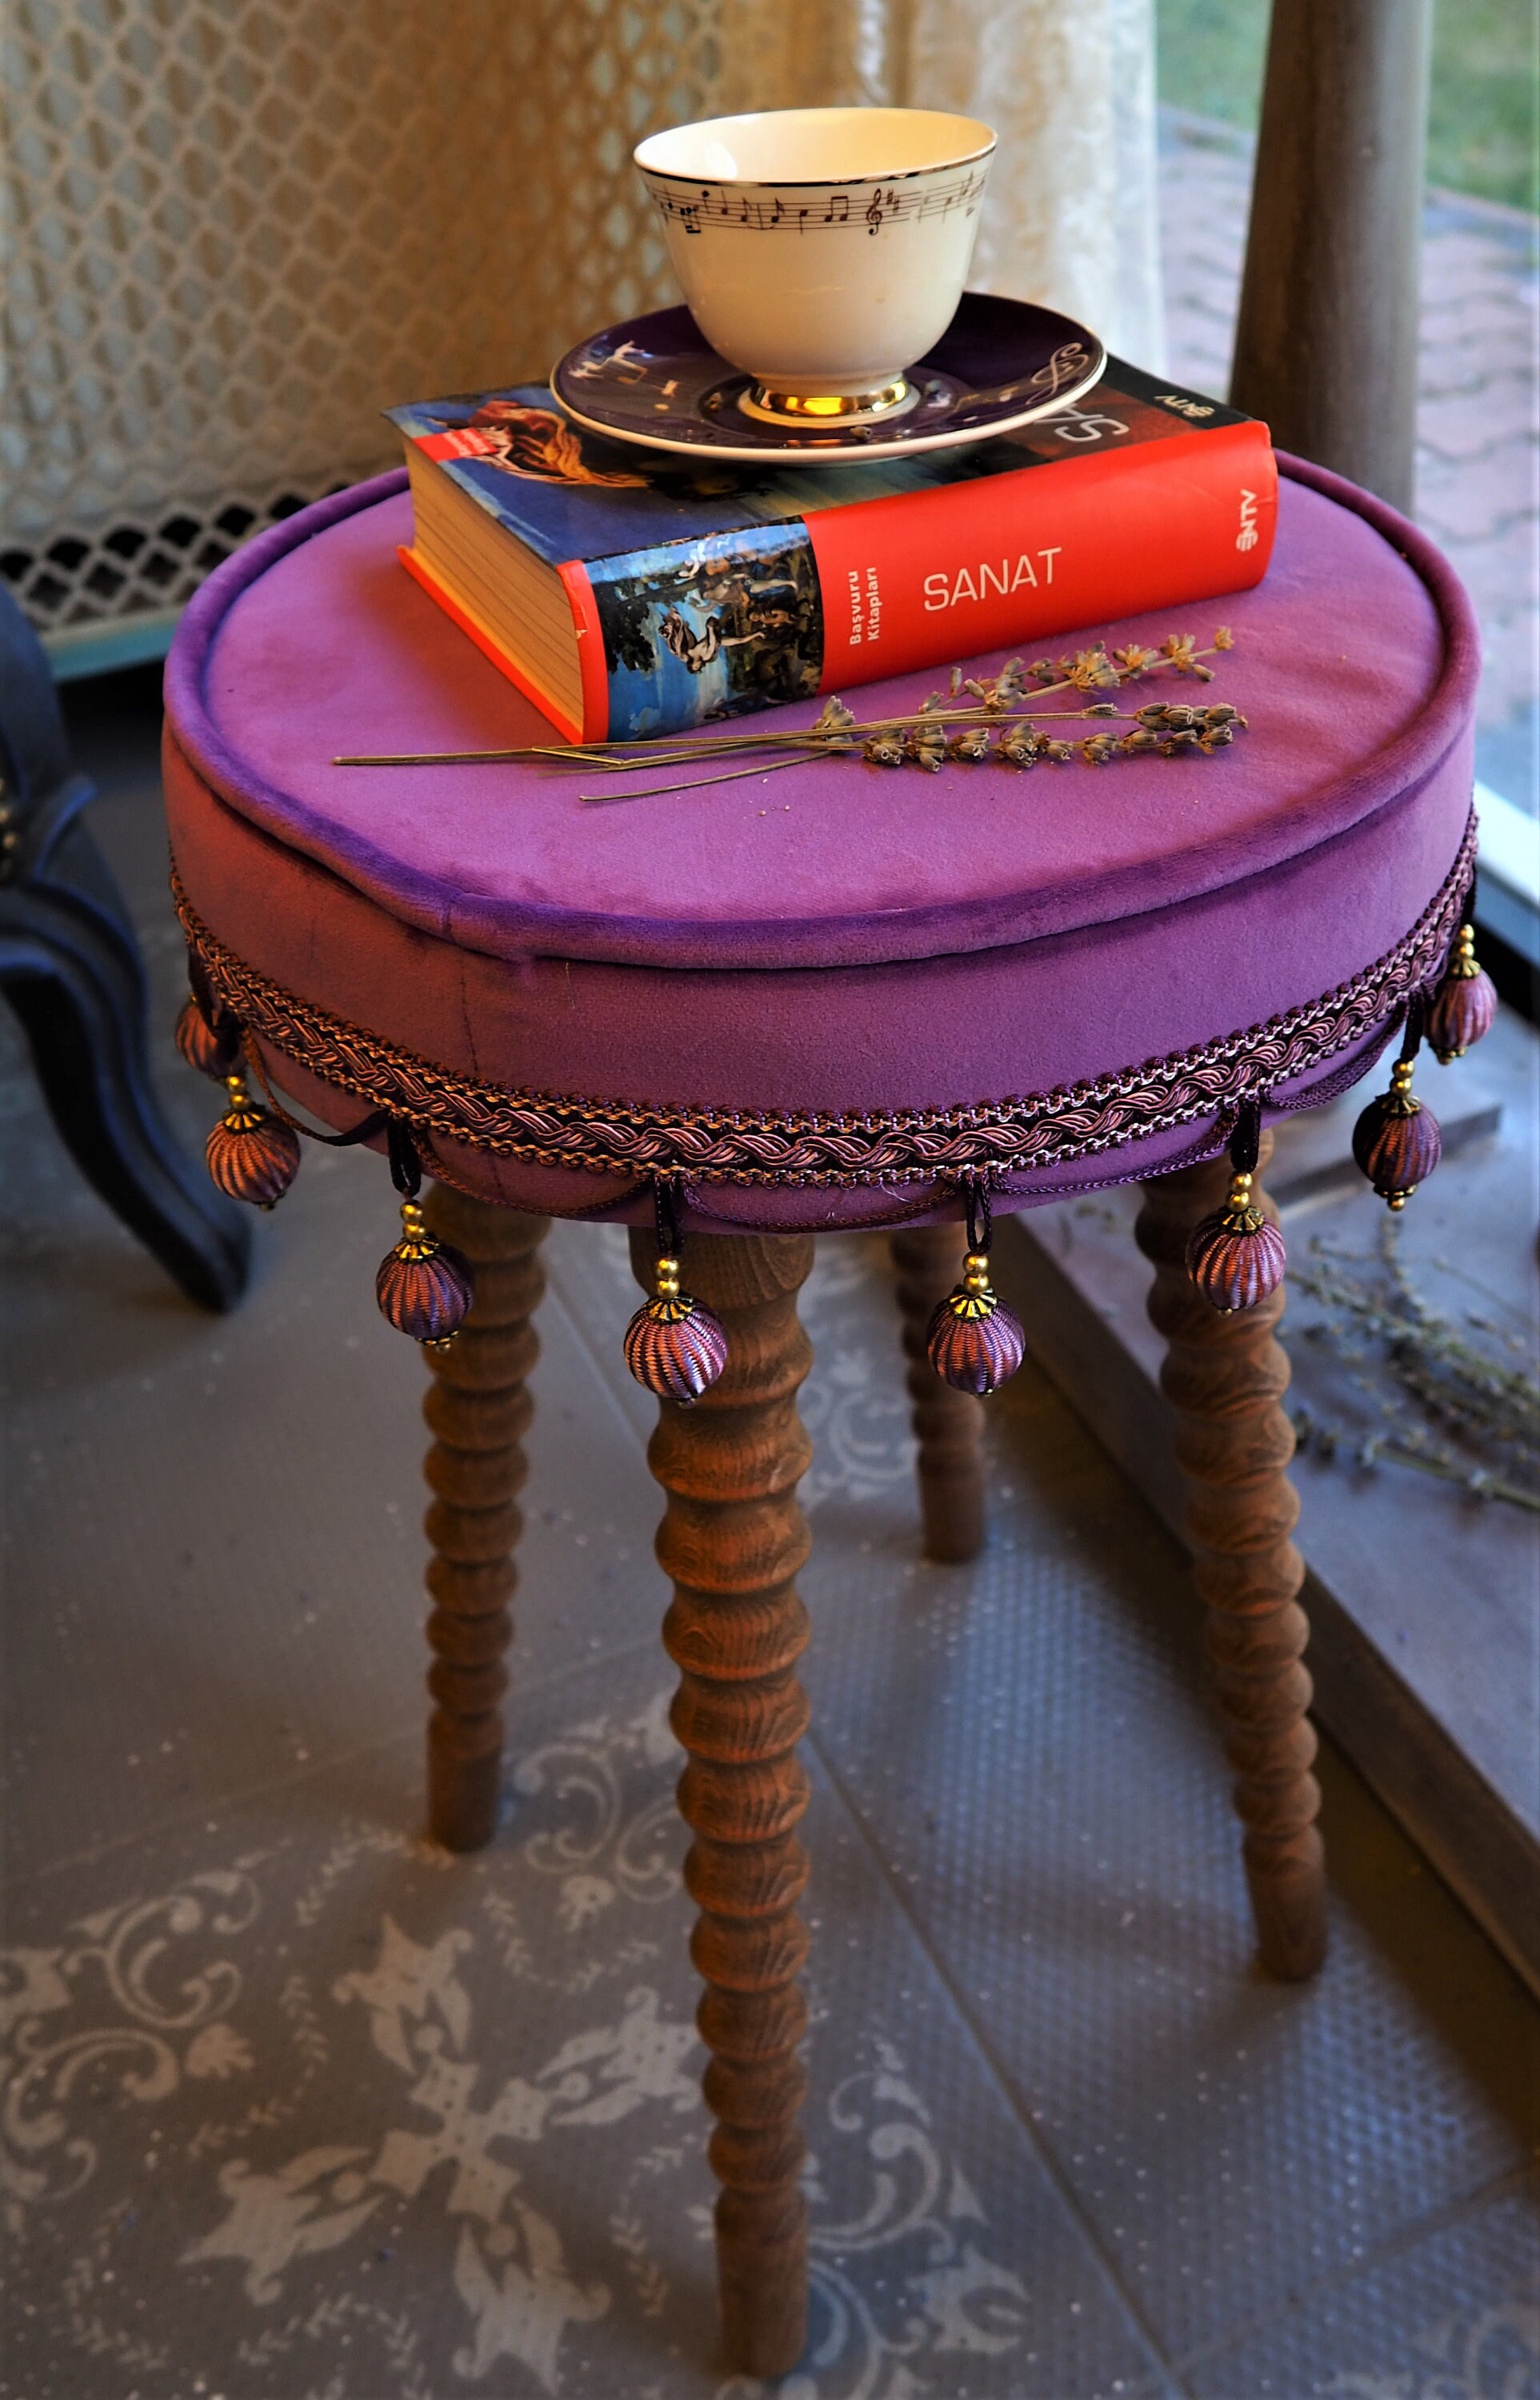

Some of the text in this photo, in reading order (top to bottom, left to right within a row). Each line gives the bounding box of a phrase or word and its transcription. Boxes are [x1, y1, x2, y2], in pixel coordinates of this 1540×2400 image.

[1238, 489, 1258, 546] NTV
[848, 570, 865, 646] Başvuru
[866, 567, 882, 641] Kitapları
[923, 546, 1062, 612] SANAT
